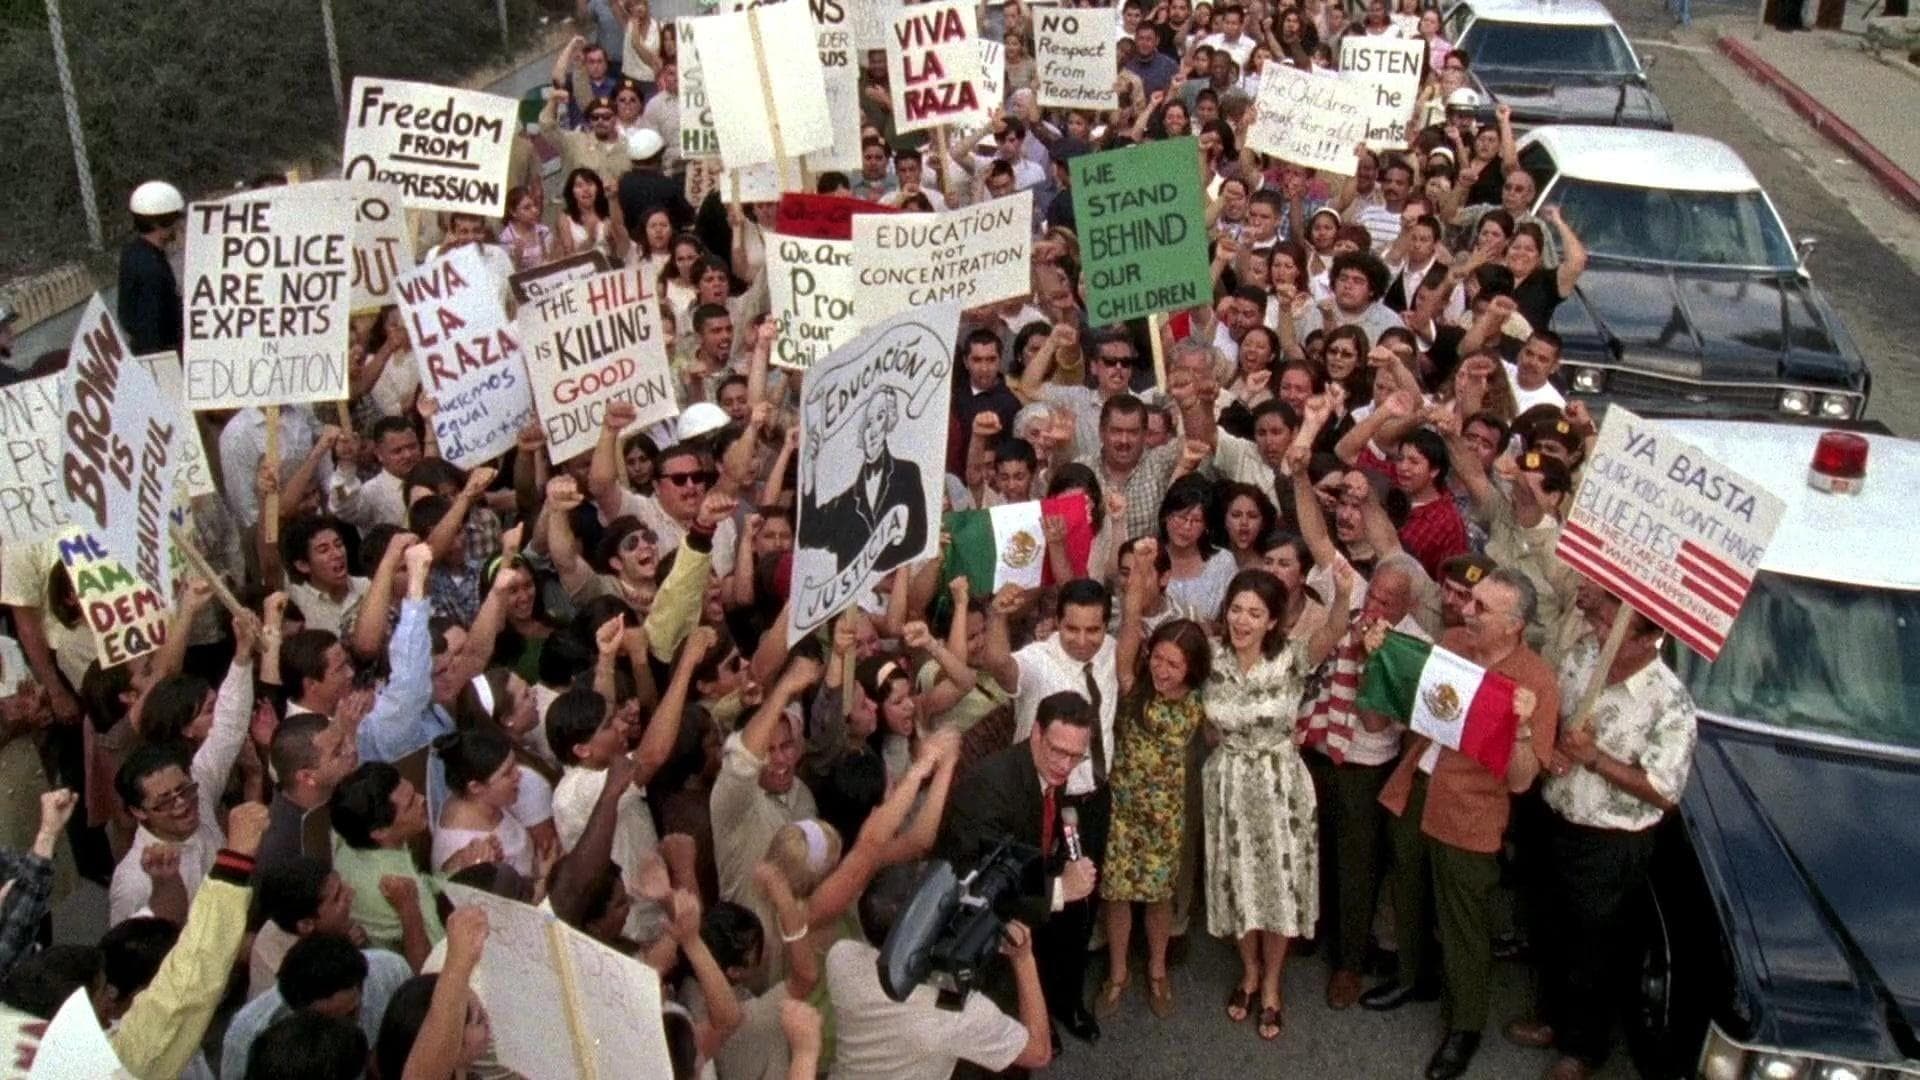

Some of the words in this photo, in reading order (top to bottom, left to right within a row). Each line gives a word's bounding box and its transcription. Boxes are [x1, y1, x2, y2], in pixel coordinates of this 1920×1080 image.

[894, 8, 966, 49] VIVA
[1041, 16, 1079, 34] NO
[903, 50, 944, 85] LA
[1039, 37, 1105, 59] Respect
[1341, 48, 1420, 76] LISTEN
[1044, 61, 1086, 79] from
[904, 81, 980, 121] RAZA
[1043, 80, 1114, 101] Teachers
[1372, 83, 1402, 108] he
[358, 86, 503, 144] Freedom
[399, 133, 470, 160] FROM
[1082, 163, 1116, 187] WE
[193, 202, 271, 234] THE
[1088, 183, 1178, 217] STAND
[876, 207, 1014, 250] EDUCATION
[1089, 213, 1188, 260] BEHIND
[222, 235, 345, 268] POLICE
[779, 241, 812, 264] We
[860, 245, 1024, 286] CONCENTRATION
[930, 244, 966, 262] NOT
[190, 273, 264, 306] ARE
[281, 271, 346, 304] NOT
[397, 260, 469, 305] VIVA
[535, 288, 578, 322] THE
[586, 270, 654, 316] HILL
[790, 267, 854, 320] Pro
[908, 278, 977, 307] CAMPS
[1092, 263, 1142, 290] OUR
[1097, 281, 1197, 319] CHILDREN
[190, 304, 331, 340] EXPERTS
[412, 306, 468, 348] LA
[535, 341, 552, 361] IS
[554, 304, 651, 371] KILLING
[775, 309, 792, 337] of
[799, 321, 834, 341] our
[262, 342, 279, 355] IN
[427, 328, 520, 391] RAZA
[777, 337, 832, 367] Chil
[188, 352, 345, 400] EDUCATION
[553, 358, 636, 405] GOOD
[63, 311, 123, 530] BROWN
[436, 401, 489, 439] equal
[546, 374, 668, 445] EDUCION
[109, 432, 134, 492] IS
[1623, 424, 1656, 467] YA
[1667, 455, 1757, 523] BASTA
[135, 416, 174, 597] BEAUTIFUL
[1577, 478, 1633, 532] BLUE
[1628, 511, 1681, 559] EYES
[1590, 453, 1632, 488] OUR
[1720, 527, 1766, 569] HAVE
[807, 510, 902, 617] JUSTICIA
[89, 588, 166, 633] DEM
[103, 618, 167, 664] EQU
